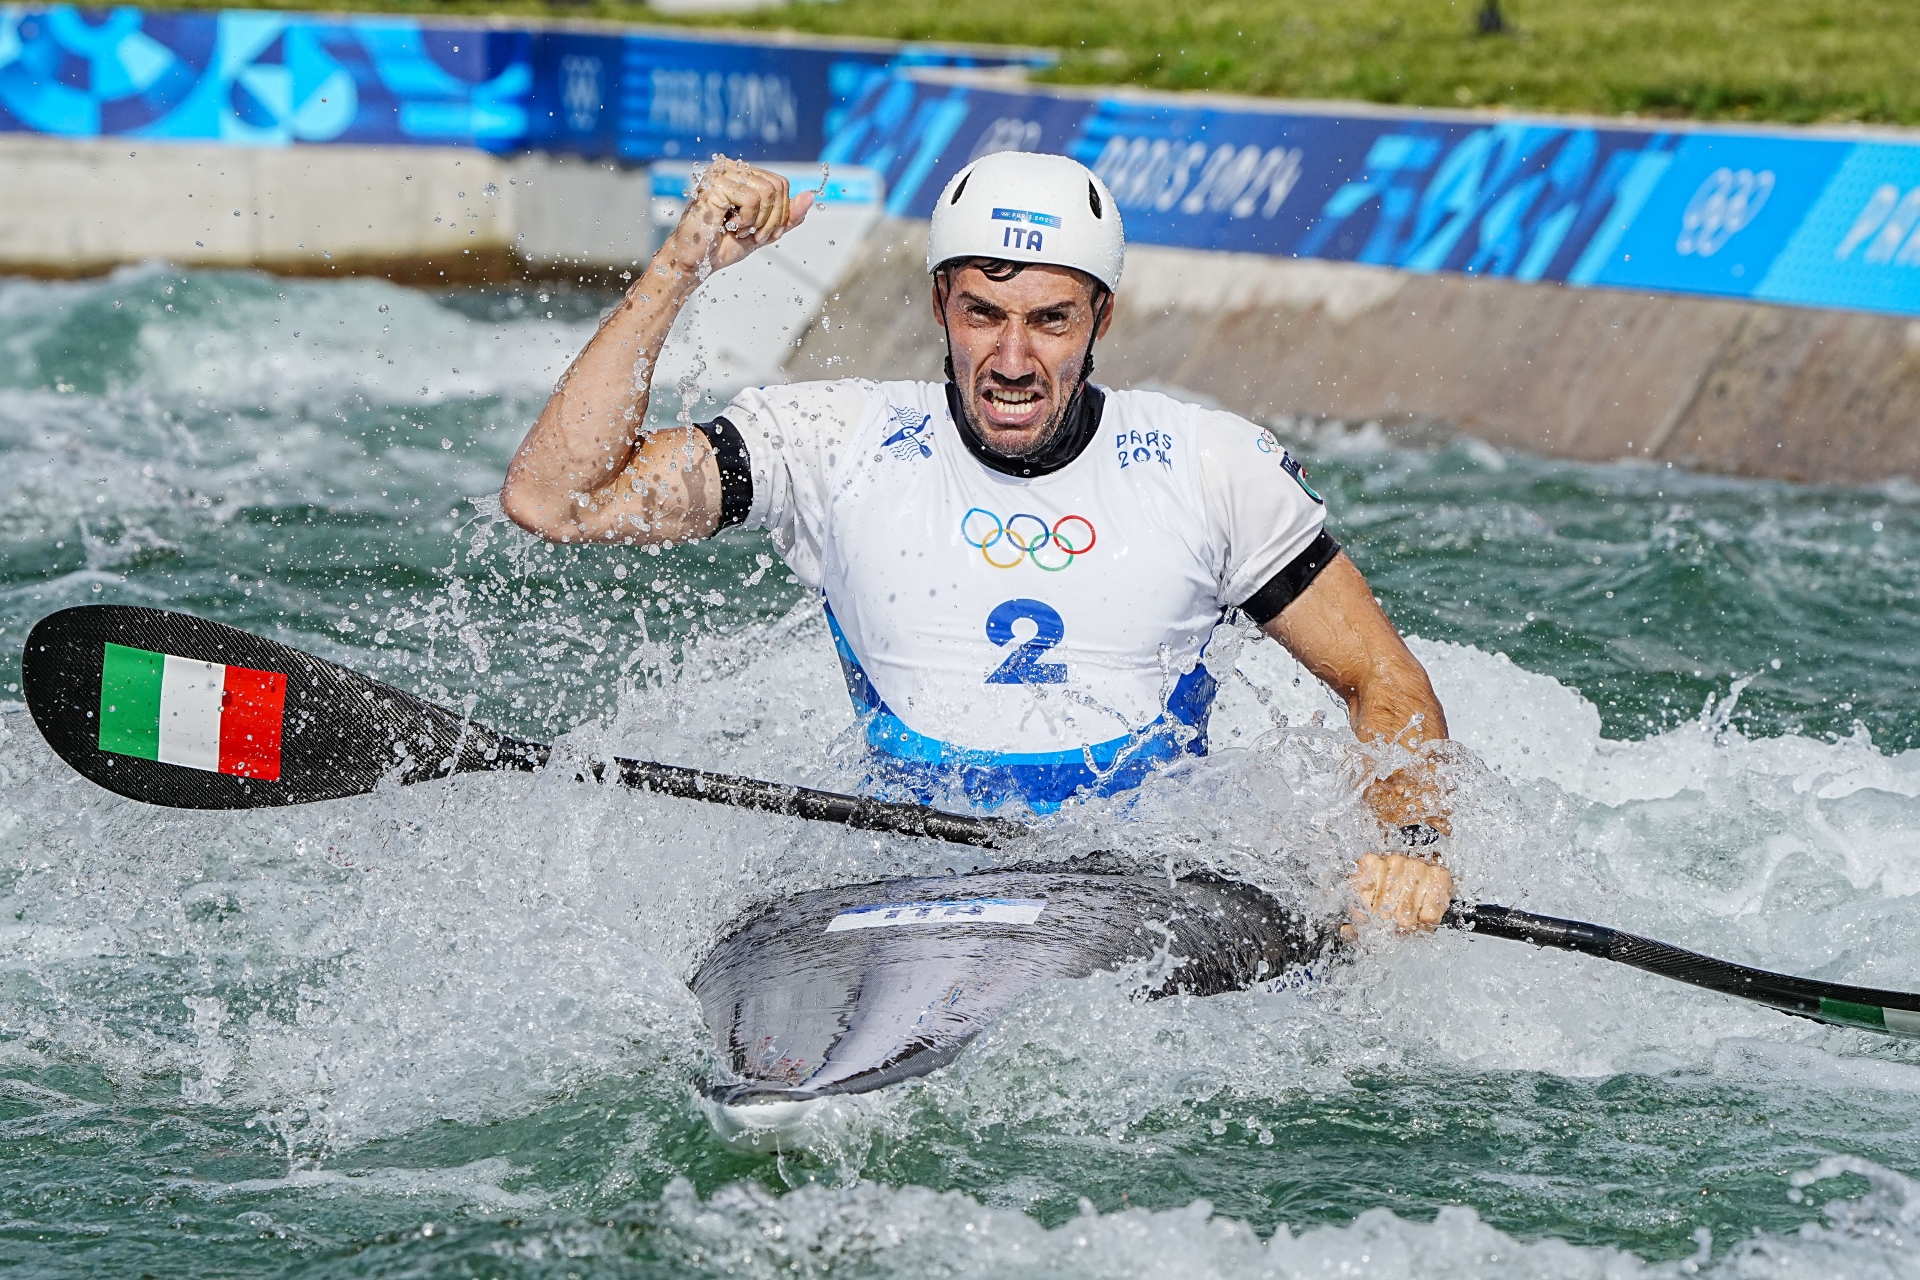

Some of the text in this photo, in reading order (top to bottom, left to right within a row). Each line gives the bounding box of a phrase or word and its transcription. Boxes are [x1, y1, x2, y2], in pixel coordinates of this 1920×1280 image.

[1003, 226, 1043, 252] ITA
[1116, 429, 1172, 450] PARIS
[985, 598, 1068, 685] 2
